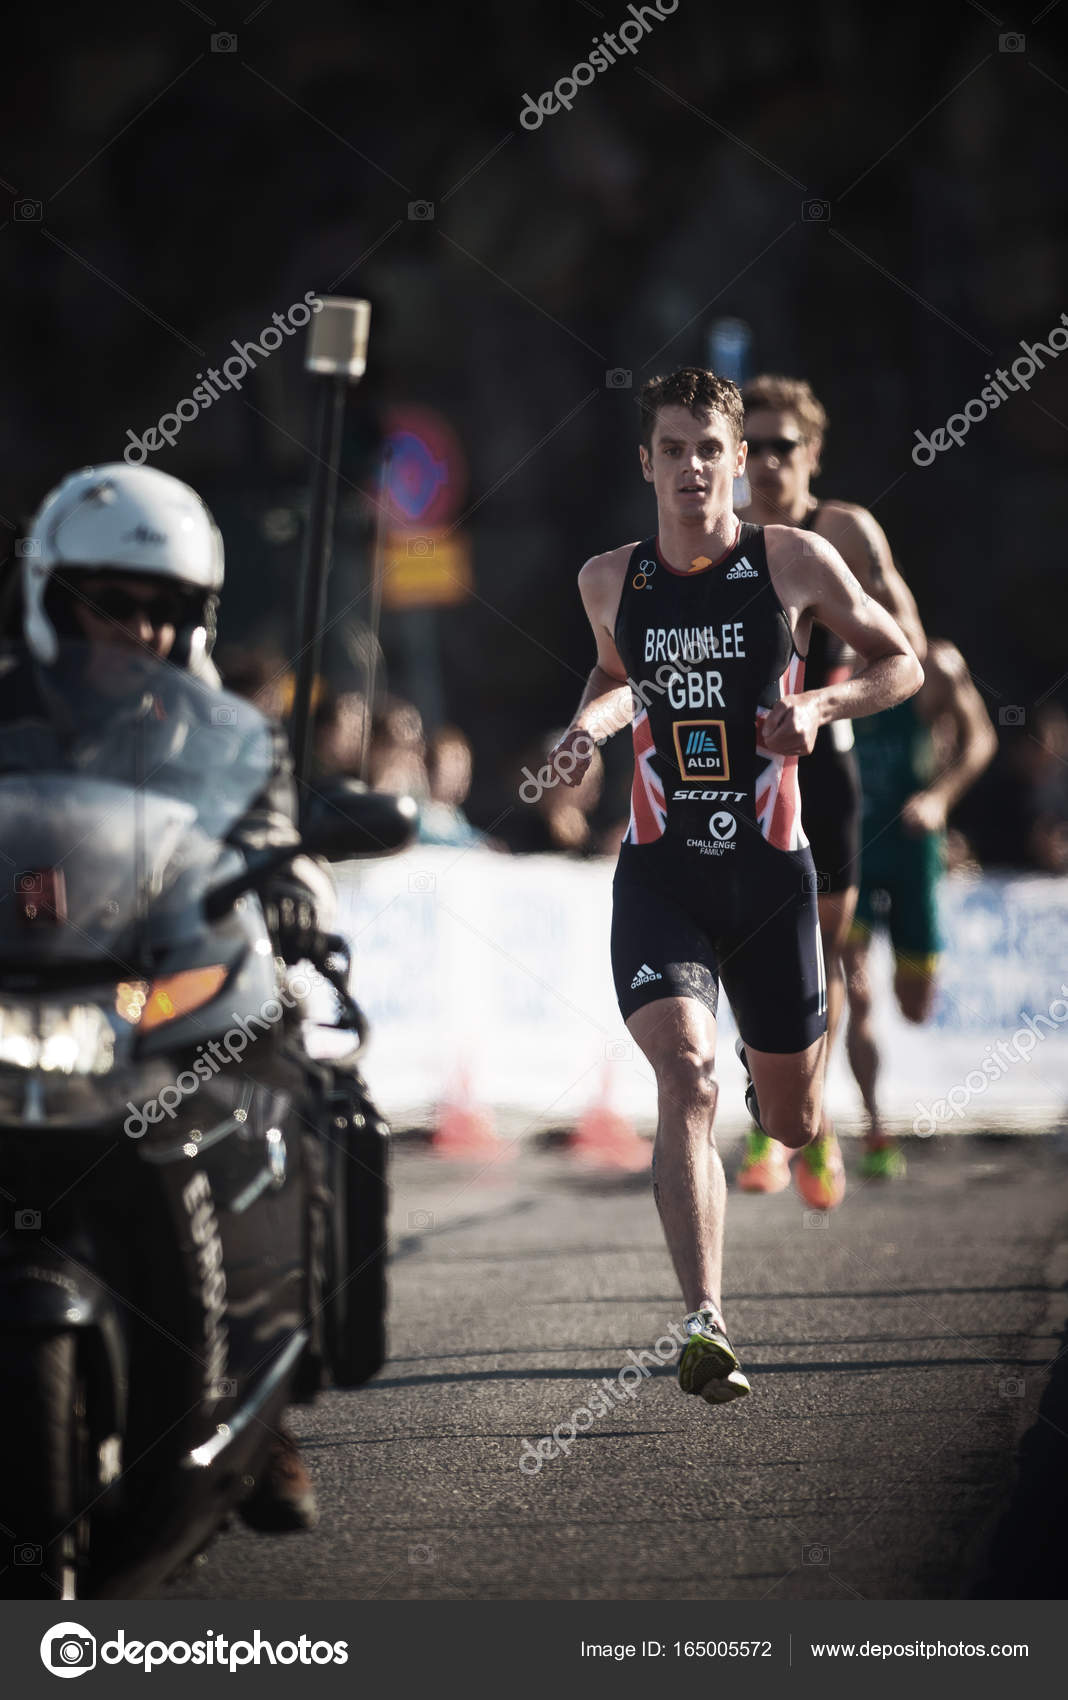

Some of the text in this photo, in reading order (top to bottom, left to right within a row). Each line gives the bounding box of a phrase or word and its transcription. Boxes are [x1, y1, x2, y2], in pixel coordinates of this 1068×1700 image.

[726, 569, 759, 580] adidas
[644, 623, 746, 662] BROWNLEE
[668, 670, 726, 709] GBR
[687, 757, 721, 768] ALDI
[672, 790, 748, 802] SCOTT
[686, 839, 737, 850] CHALLENGE
[700, 847, 725, 856] FAMILY
[631, 973, 662, 990] adidas
